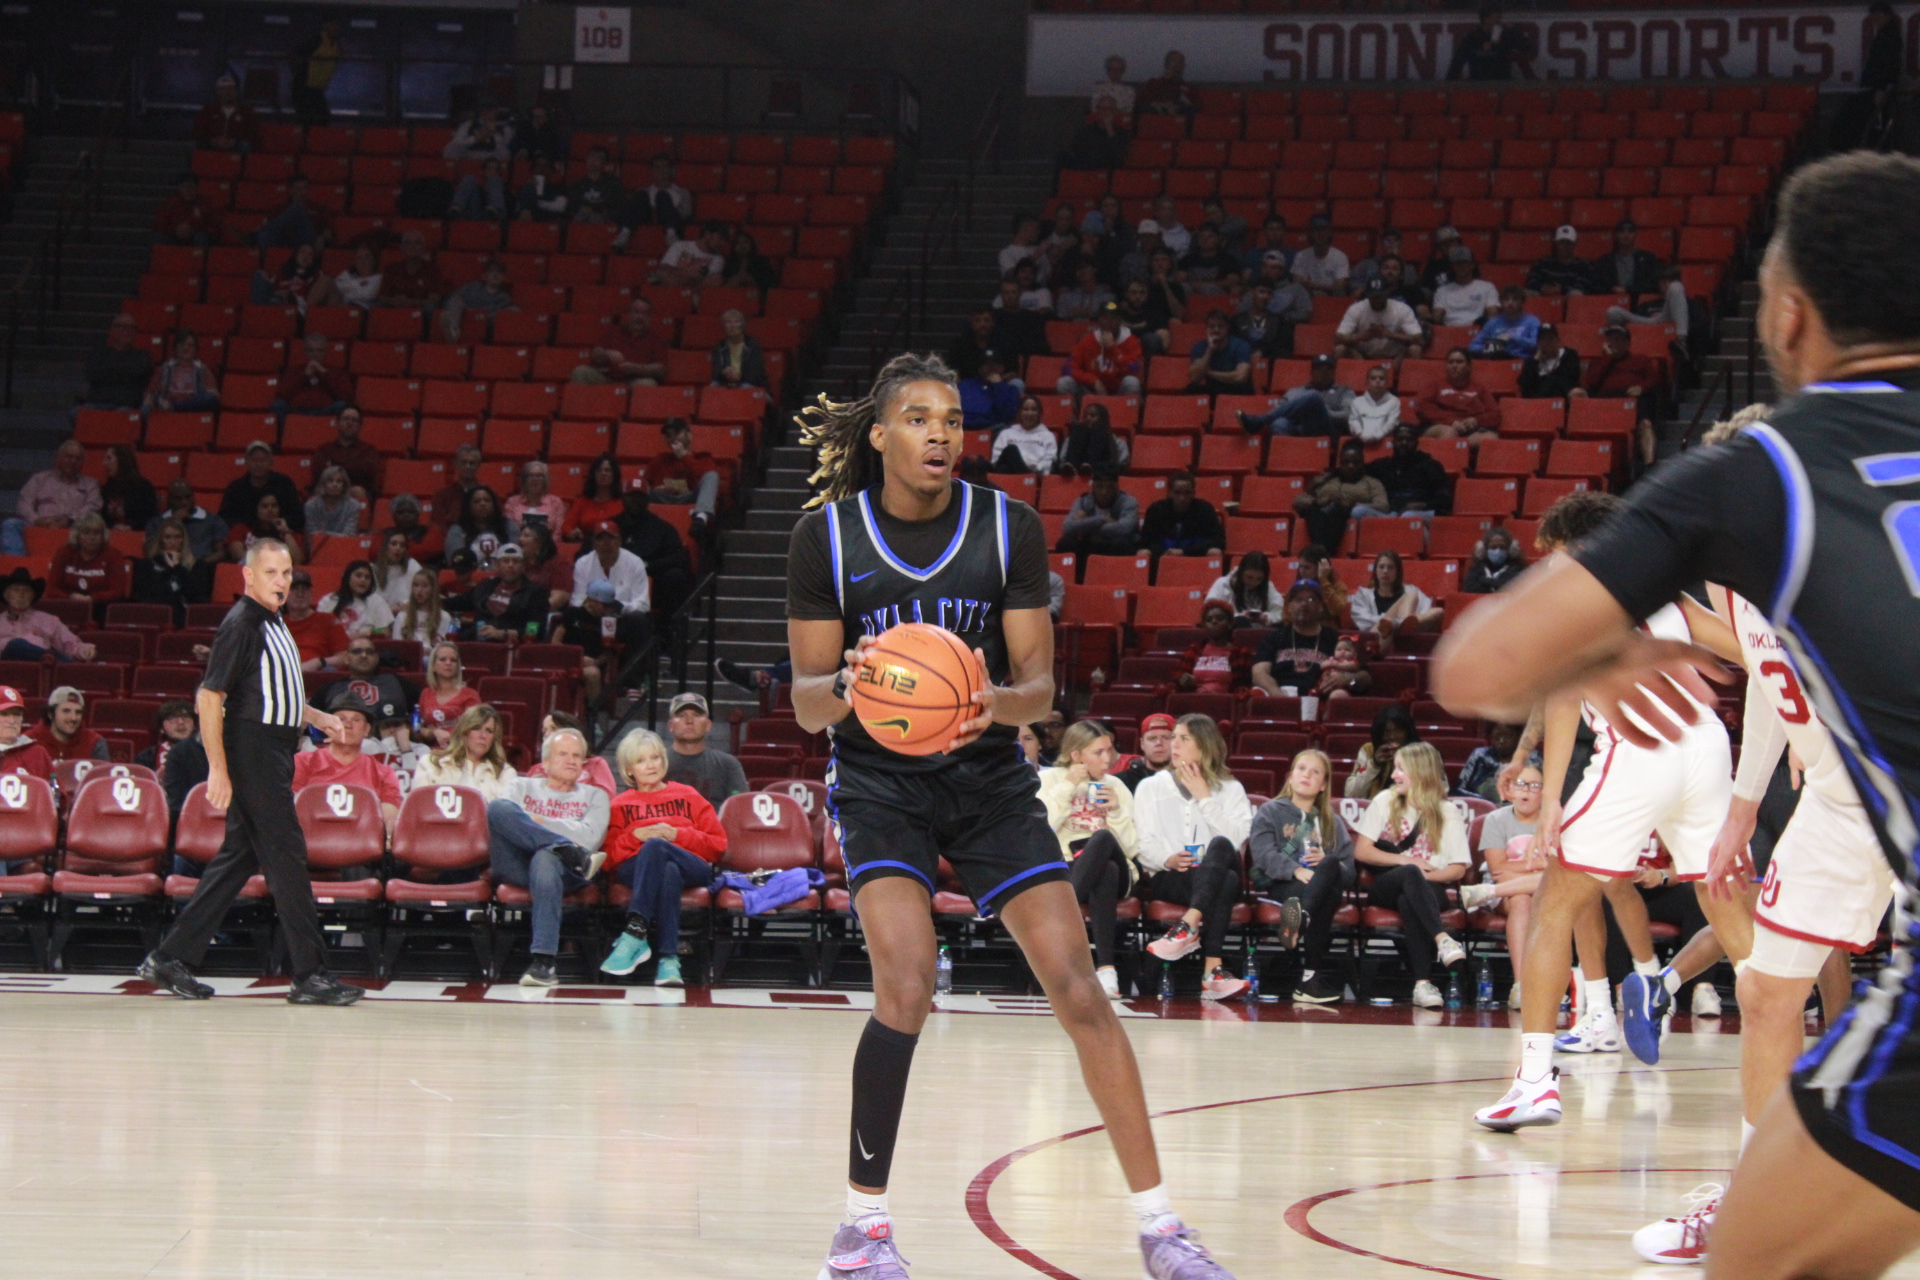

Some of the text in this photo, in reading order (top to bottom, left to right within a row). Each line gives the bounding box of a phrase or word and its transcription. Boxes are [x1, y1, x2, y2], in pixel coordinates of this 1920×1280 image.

[582, 27, 623, 49] 108
[938, 597, 992, 633] CITY
[859, 664, 917, 696] ELITE
[1760, 660, 1811, 725] 3
[0, 775, 28, 808] OU
[112, 776, 141, 811] OU
[326, 784, 355, 817] OU
[434, 786, 462, 819] OU
[523, 794, 589, 810] OKLAHOMA
[525, 804, 584, 819] SOONERS
[752, 794, 781, 826] OU
